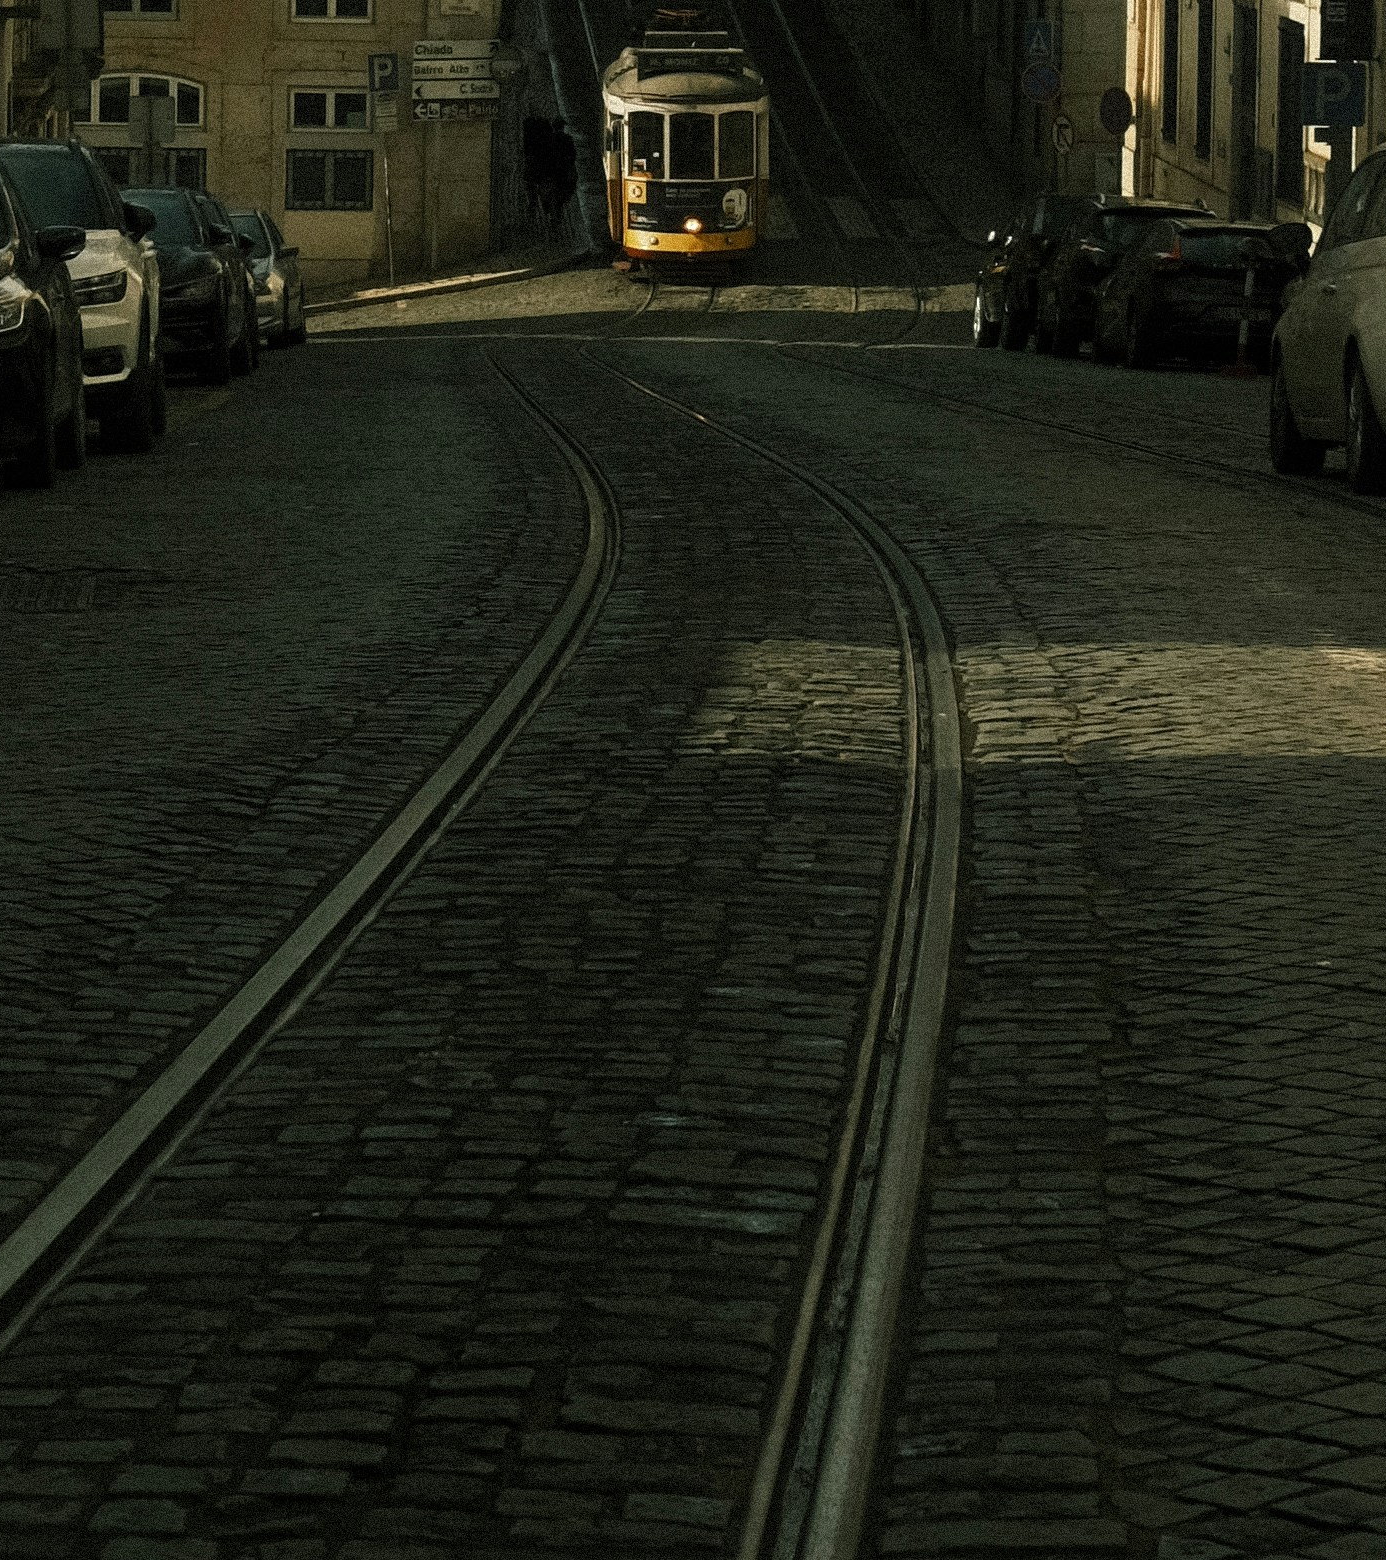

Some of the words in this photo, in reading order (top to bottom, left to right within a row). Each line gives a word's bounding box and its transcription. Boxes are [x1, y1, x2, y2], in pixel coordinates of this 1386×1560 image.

[415, 45, 453, 55] Chiado
[374, 58, 392, 88] P
[414, 66, 444, 75] Bairro
[449, 65, 470, 74] Alto
[1316, 69, 1352, 122] P
